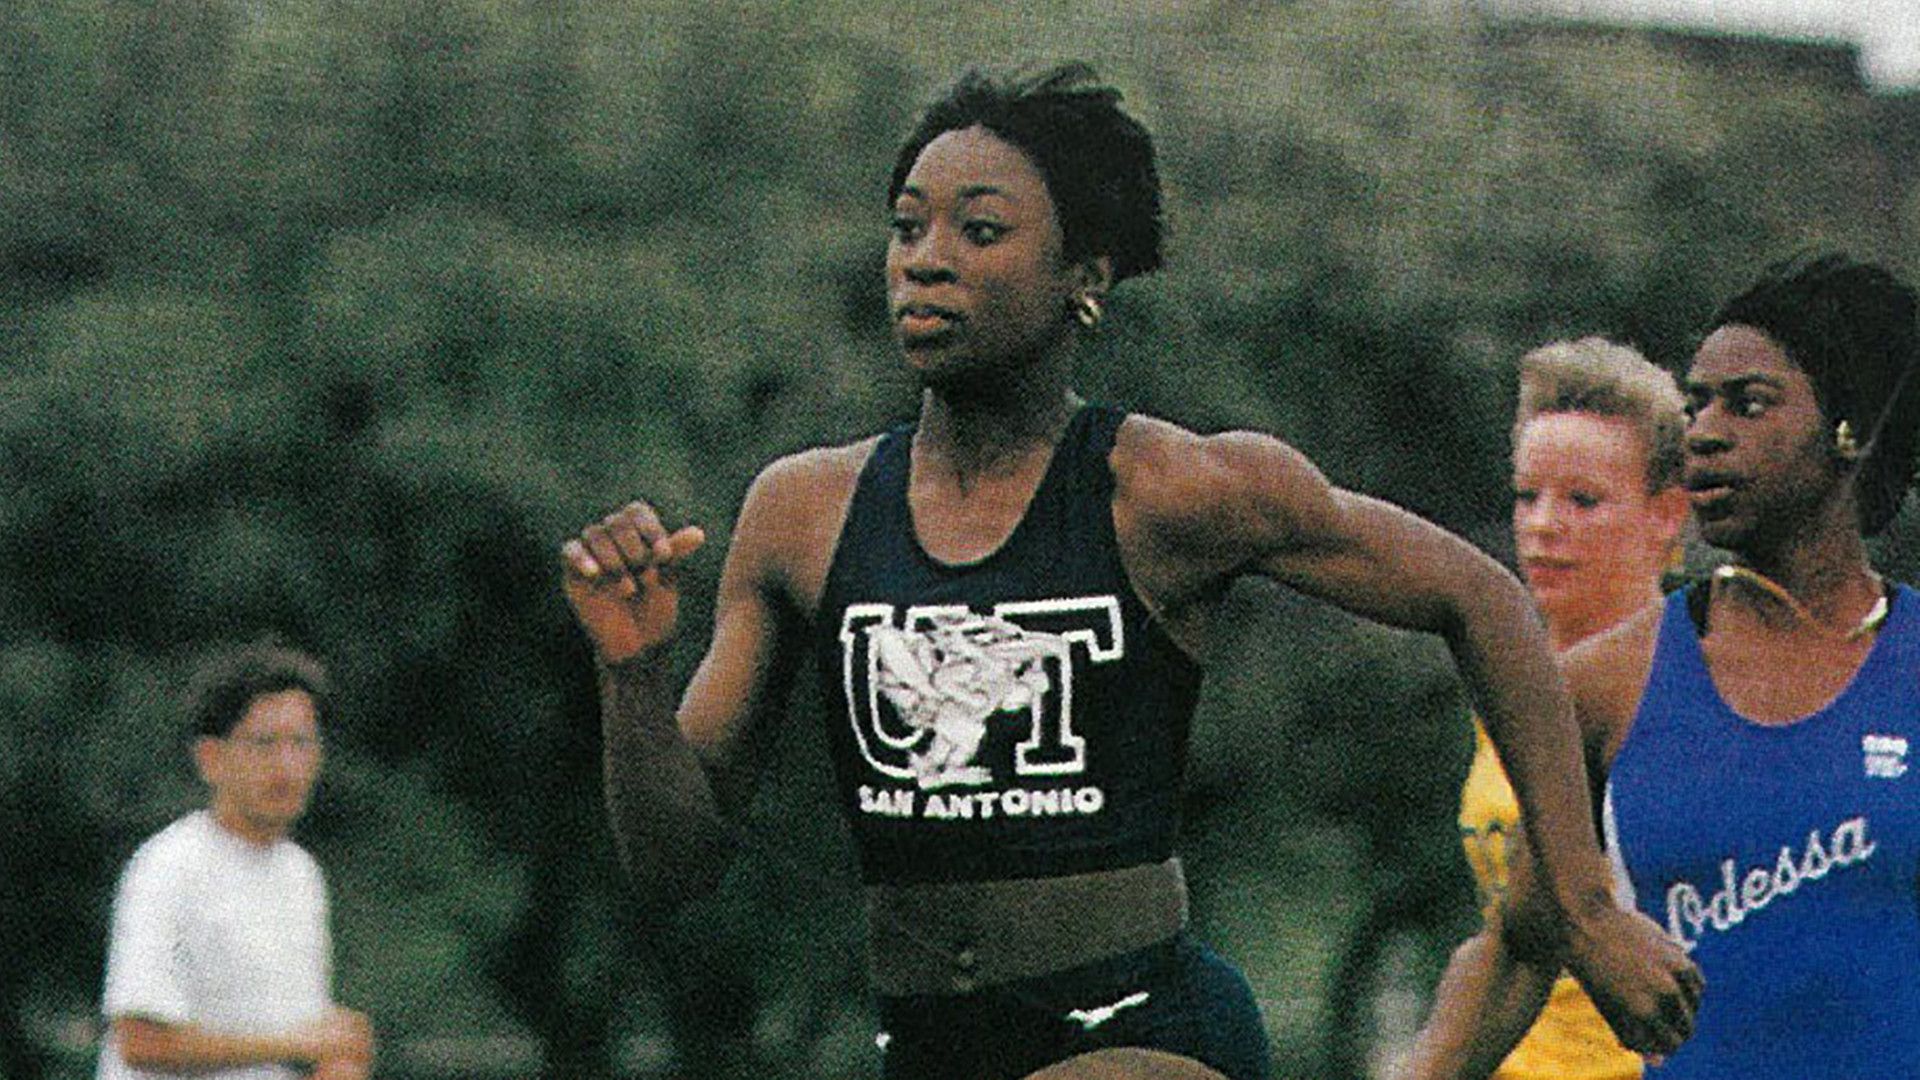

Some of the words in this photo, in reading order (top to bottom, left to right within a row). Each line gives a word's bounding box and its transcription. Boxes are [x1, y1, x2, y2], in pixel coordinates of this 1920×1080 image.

[840, 595, 1124, 779] UT
[858, 784, 914, 815] SAN
[922, 787, 1104, 818] ANTONIO
[1667, 817, 1876, 953] Odessa
